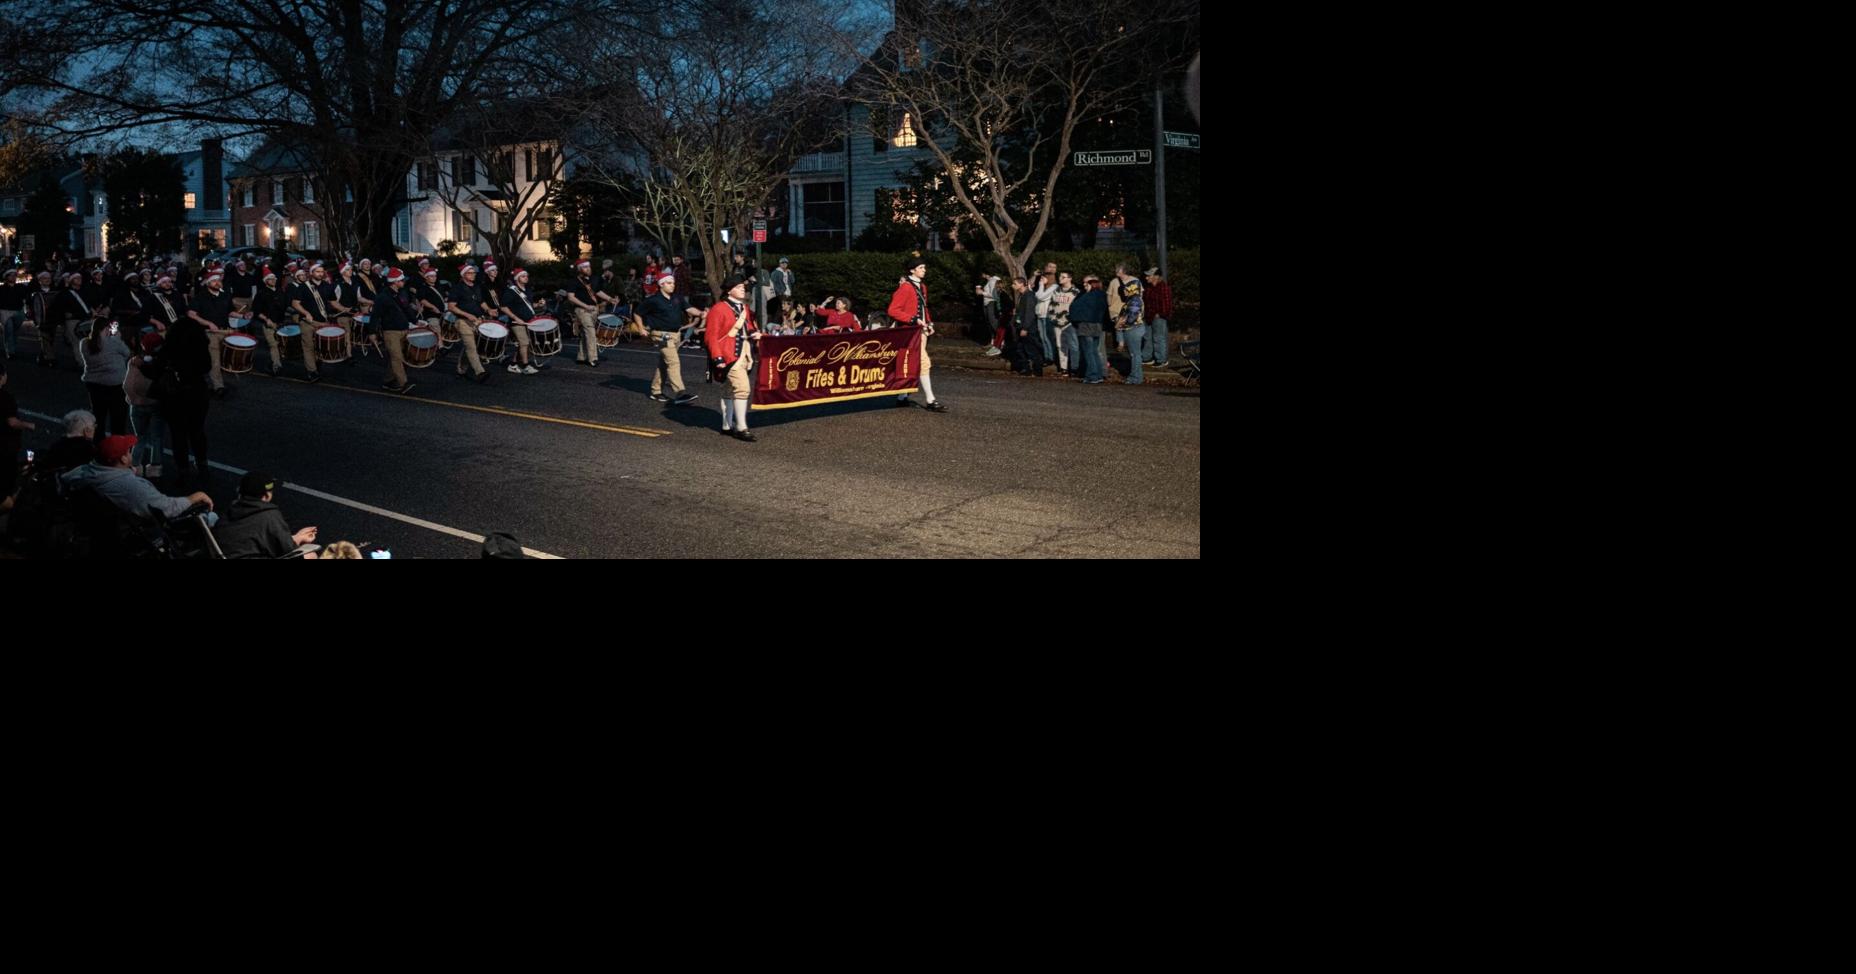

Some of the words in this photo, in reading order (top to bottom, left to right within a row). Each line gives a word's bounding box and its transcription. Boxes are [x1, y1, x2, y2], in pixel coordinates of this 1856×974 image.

[1165, 134, 1189, 146] Virginia
[1078, 151, 1136, 164] Richmond
[777, 347, 826, 372] Colonial
[805, 368, 834, 388] Fifes
[837, 365, 847, 386] &
[850, 365, 886, 384] Drums
